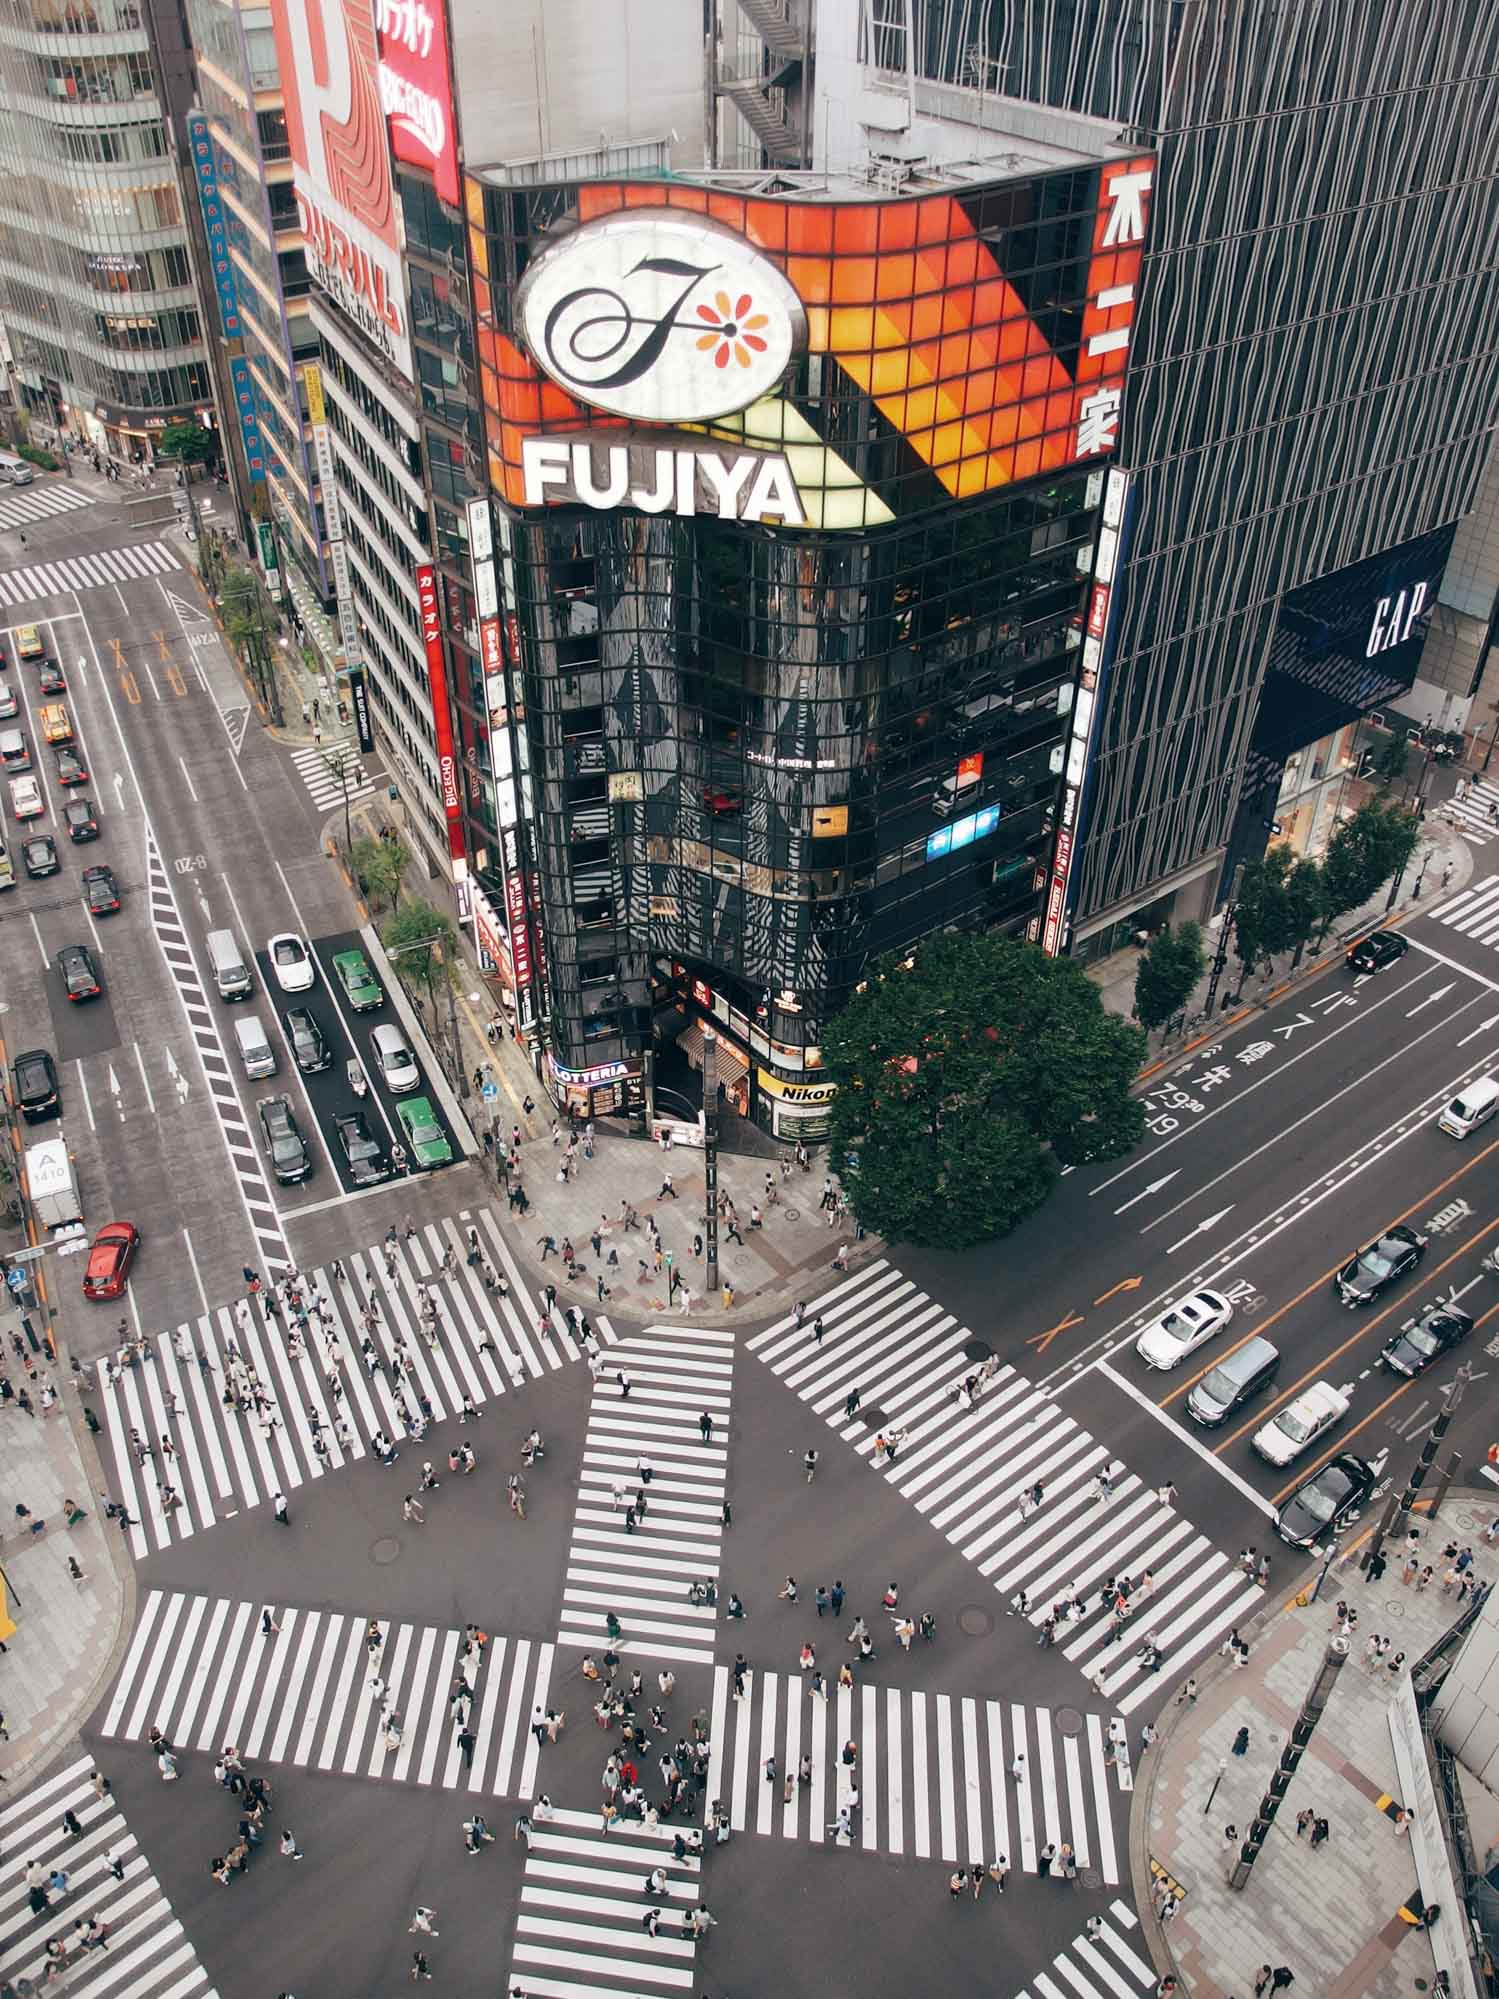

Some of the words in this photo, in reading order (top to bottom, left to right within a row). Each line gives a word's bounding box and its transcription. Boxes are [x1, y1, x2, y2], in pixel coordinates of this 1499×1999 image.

[1076, 171, 1152, 458] 不二家
[522, 440, 807, 524] FUJIYA
[419, 575, 440, 643] カラオケ
[1366, 582, 1427, 658] GAP
[441, 756, 453, 784] ECHO
[445, 785, 457, 807] BIG
[554, 1064, 629, 1084] LOTTERIA
[782, 1087, 837, 1100] Nikon
